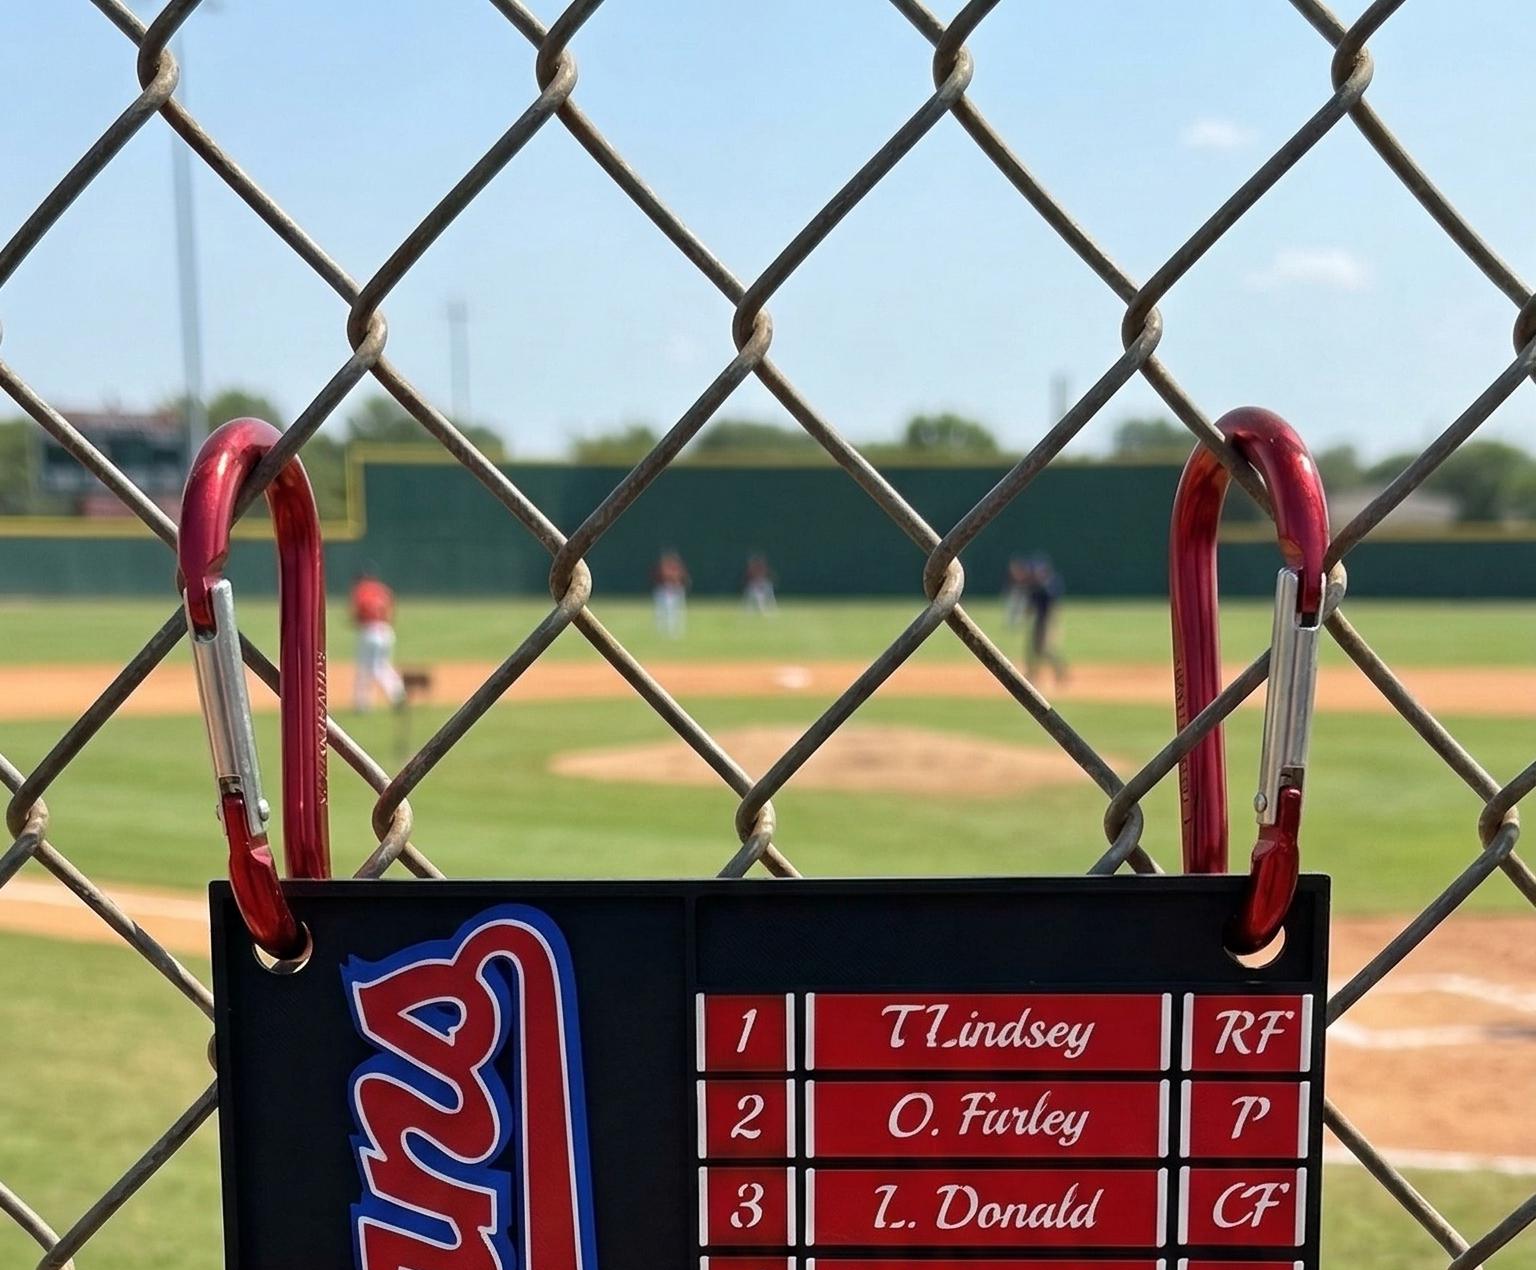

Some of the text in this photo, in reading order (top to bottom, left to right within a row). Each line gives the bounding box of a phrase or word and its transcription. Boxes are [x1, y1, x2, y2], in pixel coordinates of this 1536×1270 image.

[737, 1009, 757, 1052] 1
[1216, 1010, 1294, 1054] RF
[731, 1095, 764, 1139] 2
[889, 1093, 938, 1138] O.
[1232, 1096, 1270, 1138] P
[730, 1183, 1289, 1229] 3 L. Donald CF
